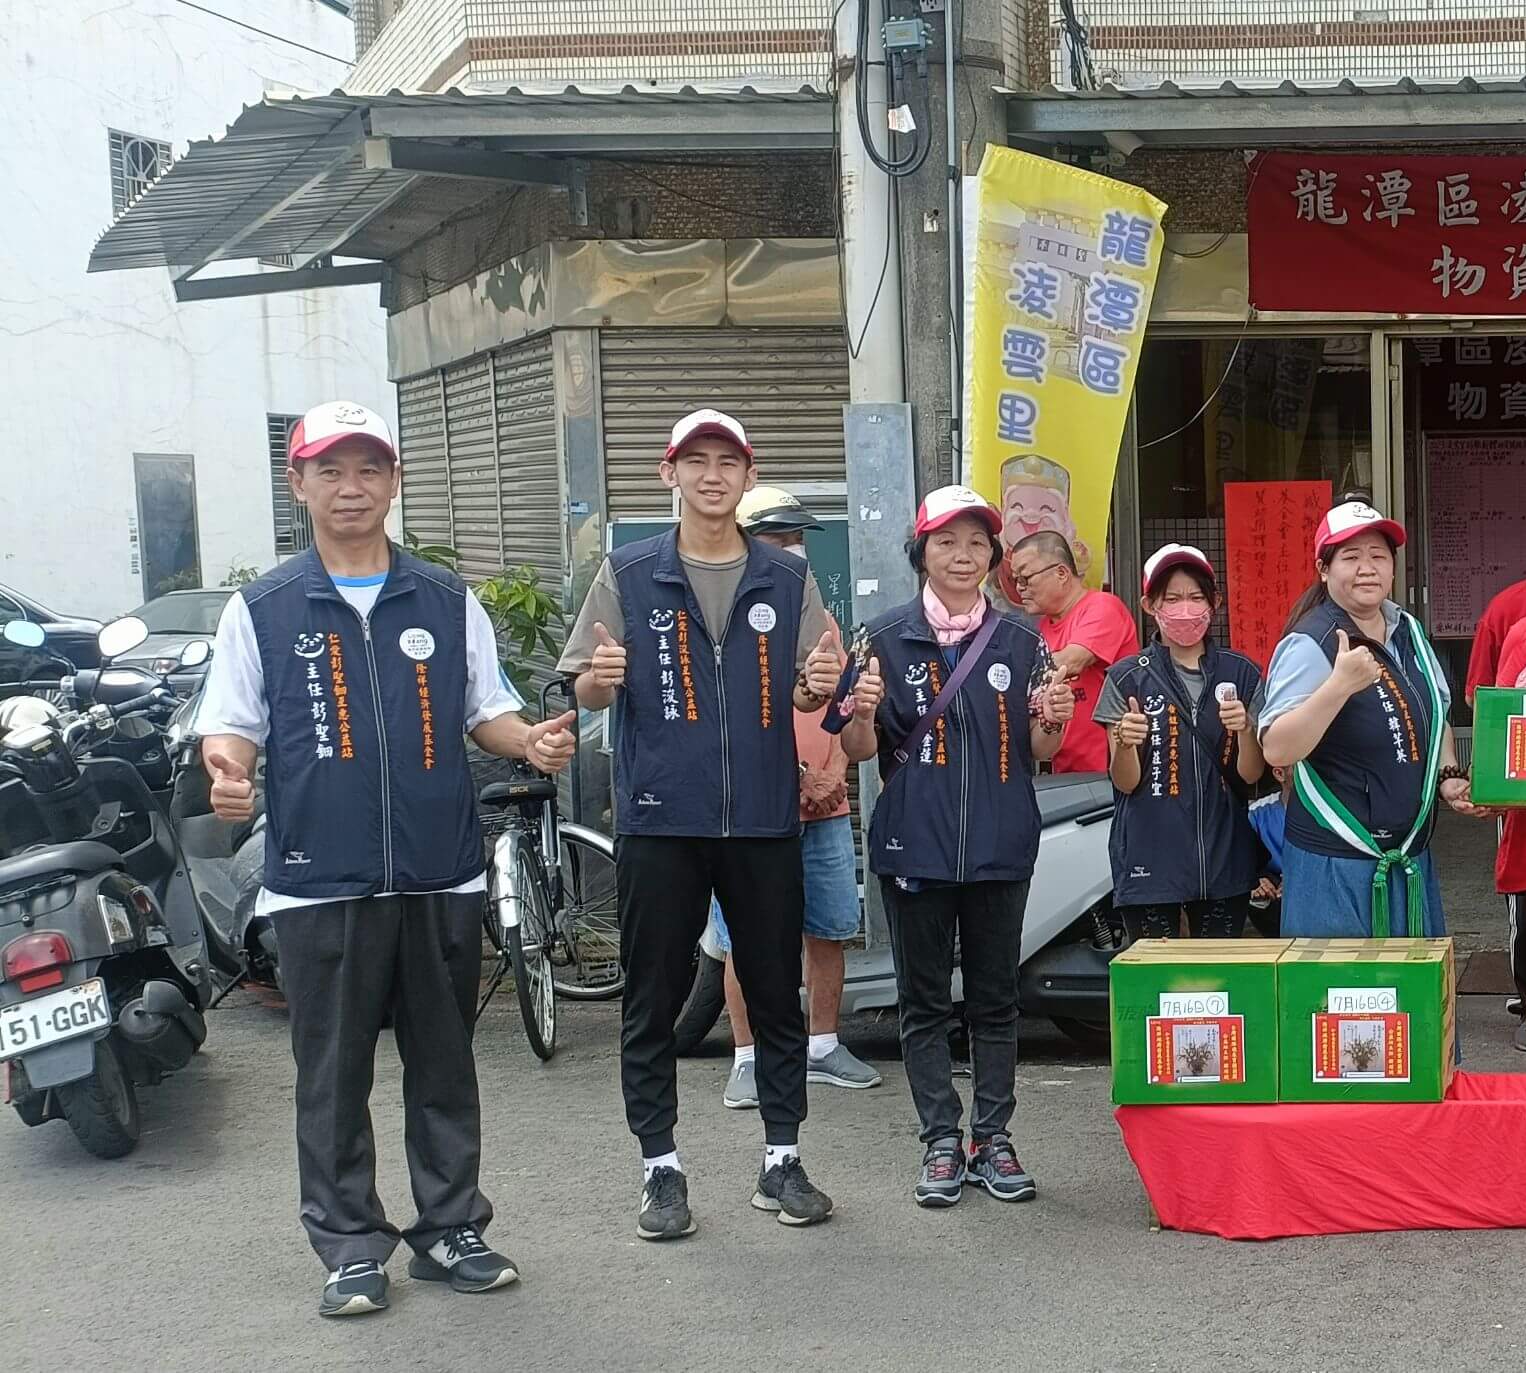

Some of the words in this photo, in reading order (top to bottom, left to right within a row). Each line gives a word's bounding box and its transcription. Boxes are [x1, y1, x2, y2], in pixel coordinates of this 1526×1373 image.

[997, 262, 1060, 444] 凌雲里
[1080, 209, 1153, 394] 龍潭區
[0, 994, 107, 1051] 51-GGK
